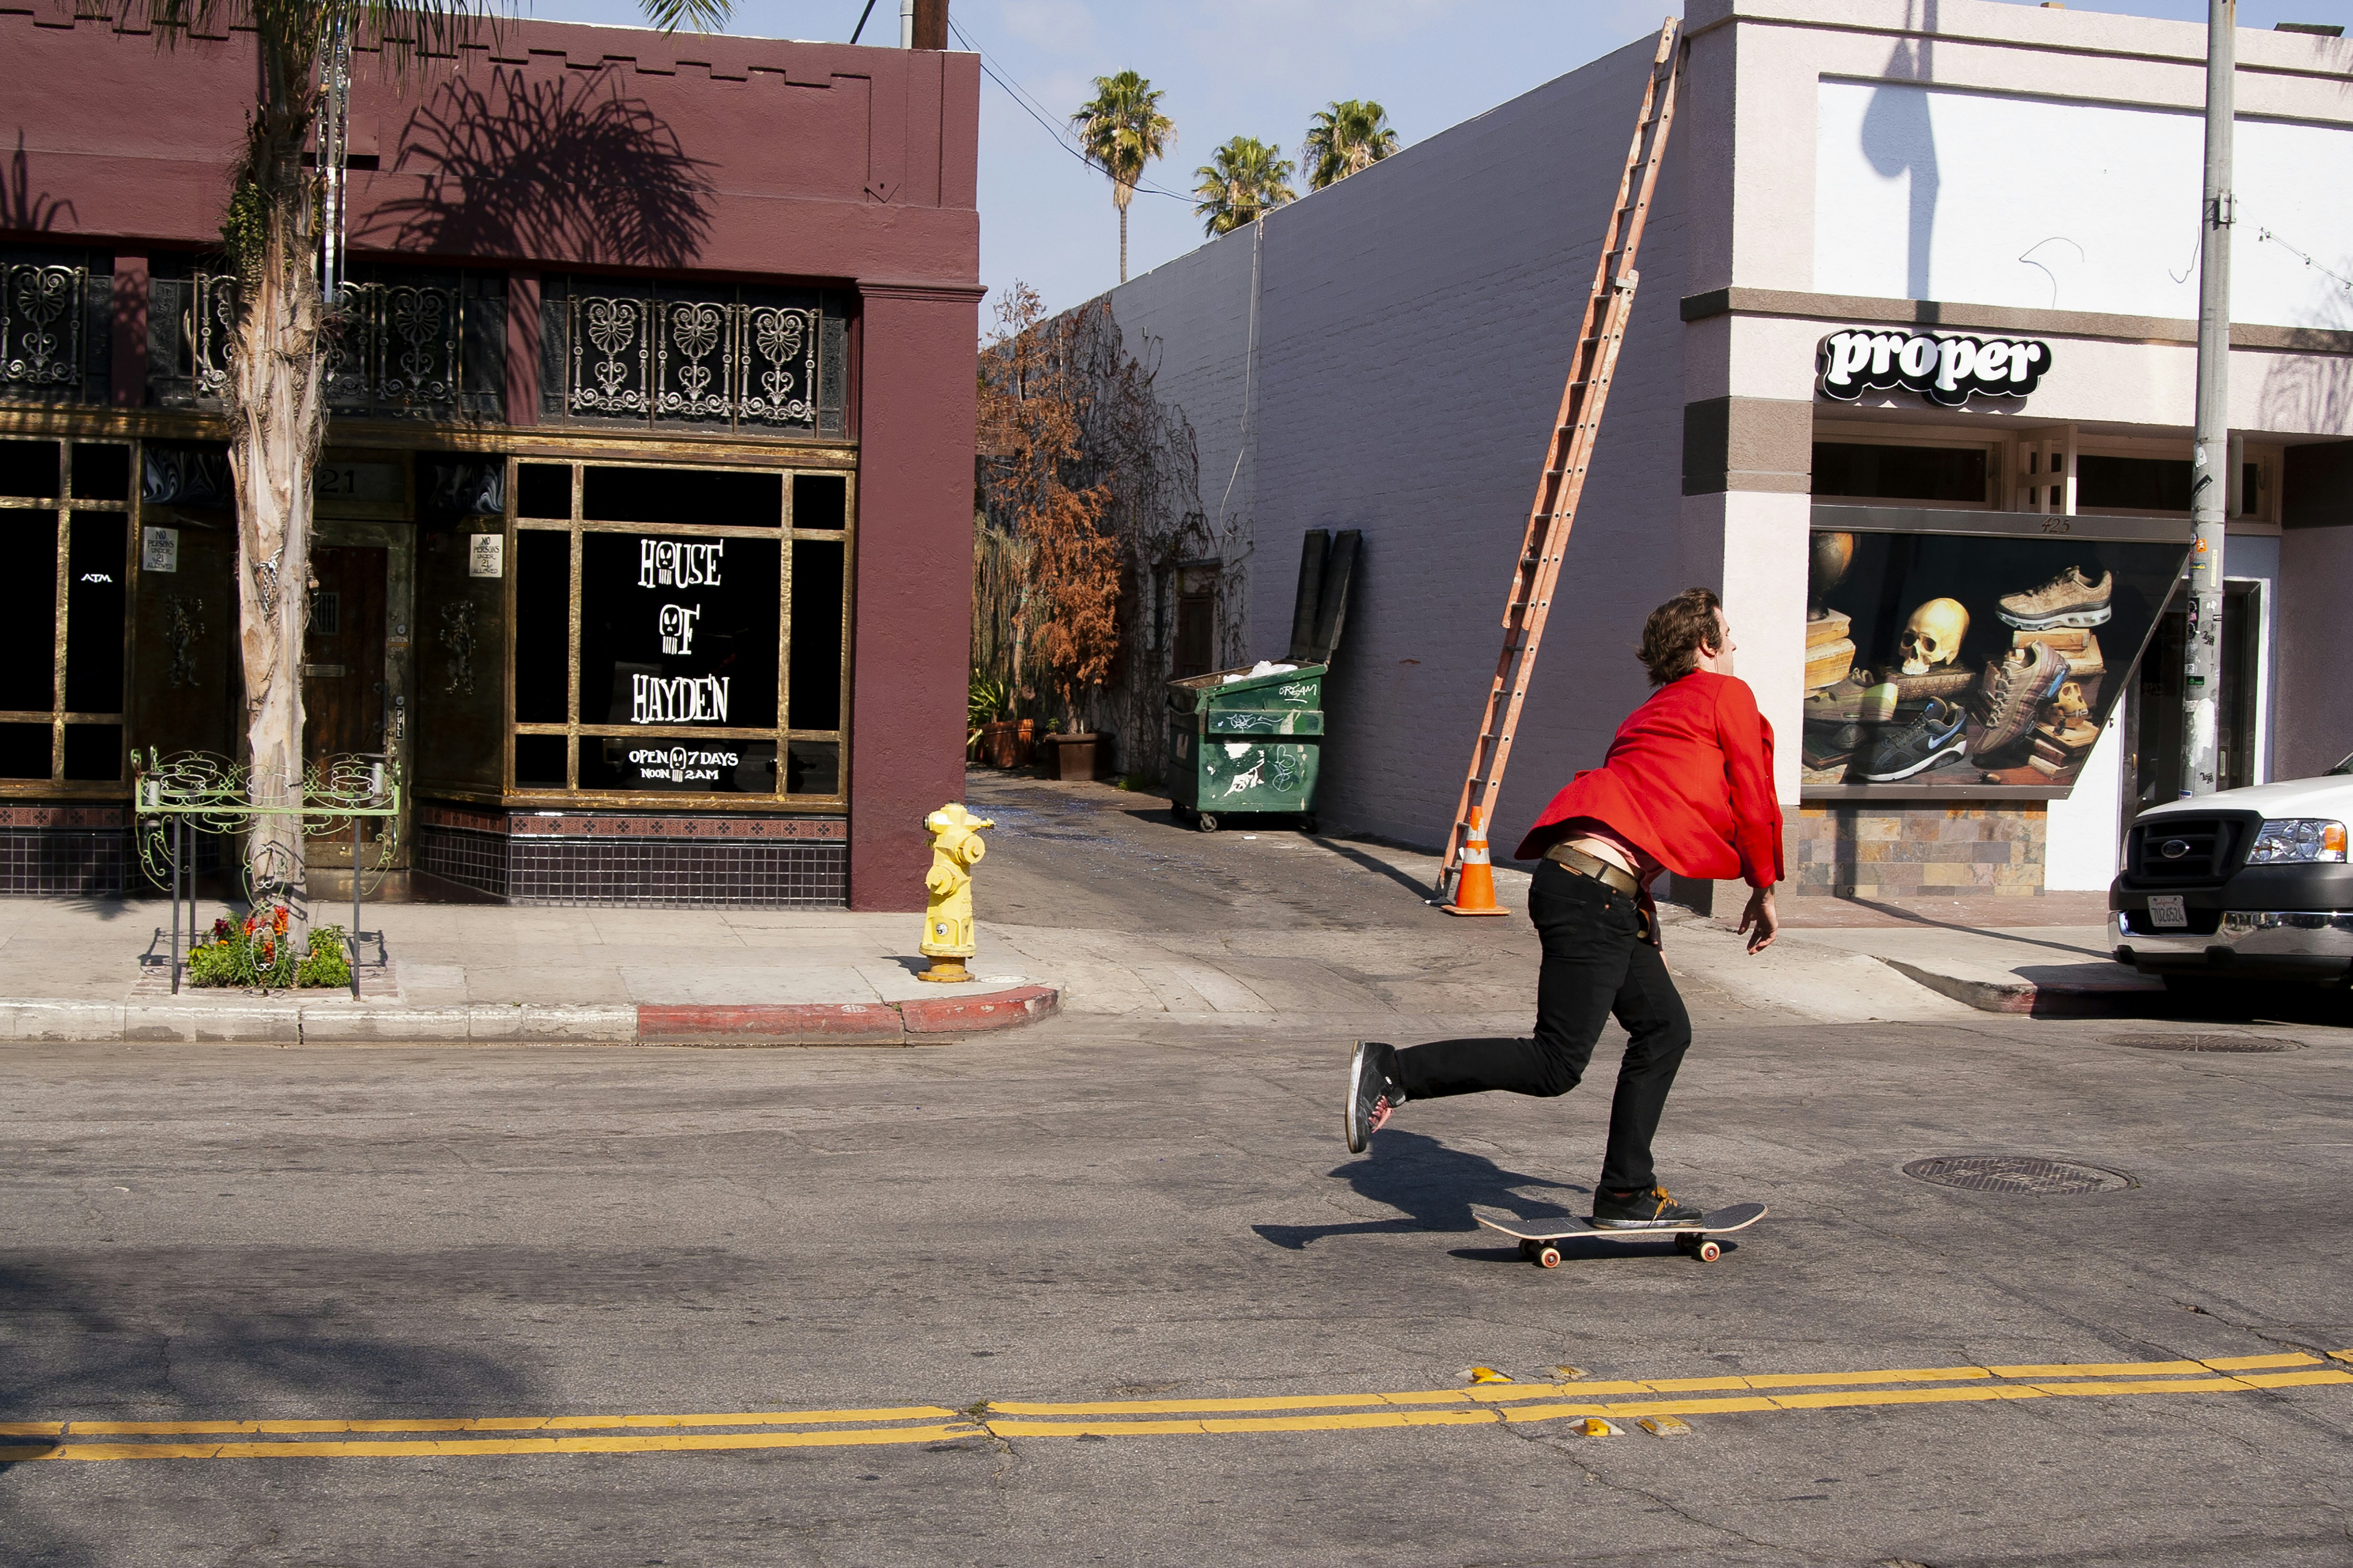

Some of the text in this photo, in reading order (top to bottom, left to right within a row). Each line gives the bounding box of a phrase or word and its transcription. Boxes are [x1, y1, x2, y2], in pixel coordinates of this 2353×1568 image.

[1828, 332, 2041, 391] proper
[2041, 517, 2070, 533] 425
[156, 530, 166, 540] NO
[481, 537, 491, 545] NO
[147, 540, 174, 548] PERSONS
[156, 554, 164, 562] 21
[481, 559, 489, 568] 21
[637, 538, 724, 589] HOUSE
[81, 573, 113, 583] ATM
[659, 603, 700, 655] OF
[630, 673, 730, 724] HAYDEN
[628, 749, 739, 767] OPEN 7 DAYS
[640, 768, 719, 780] NOON 2AM
